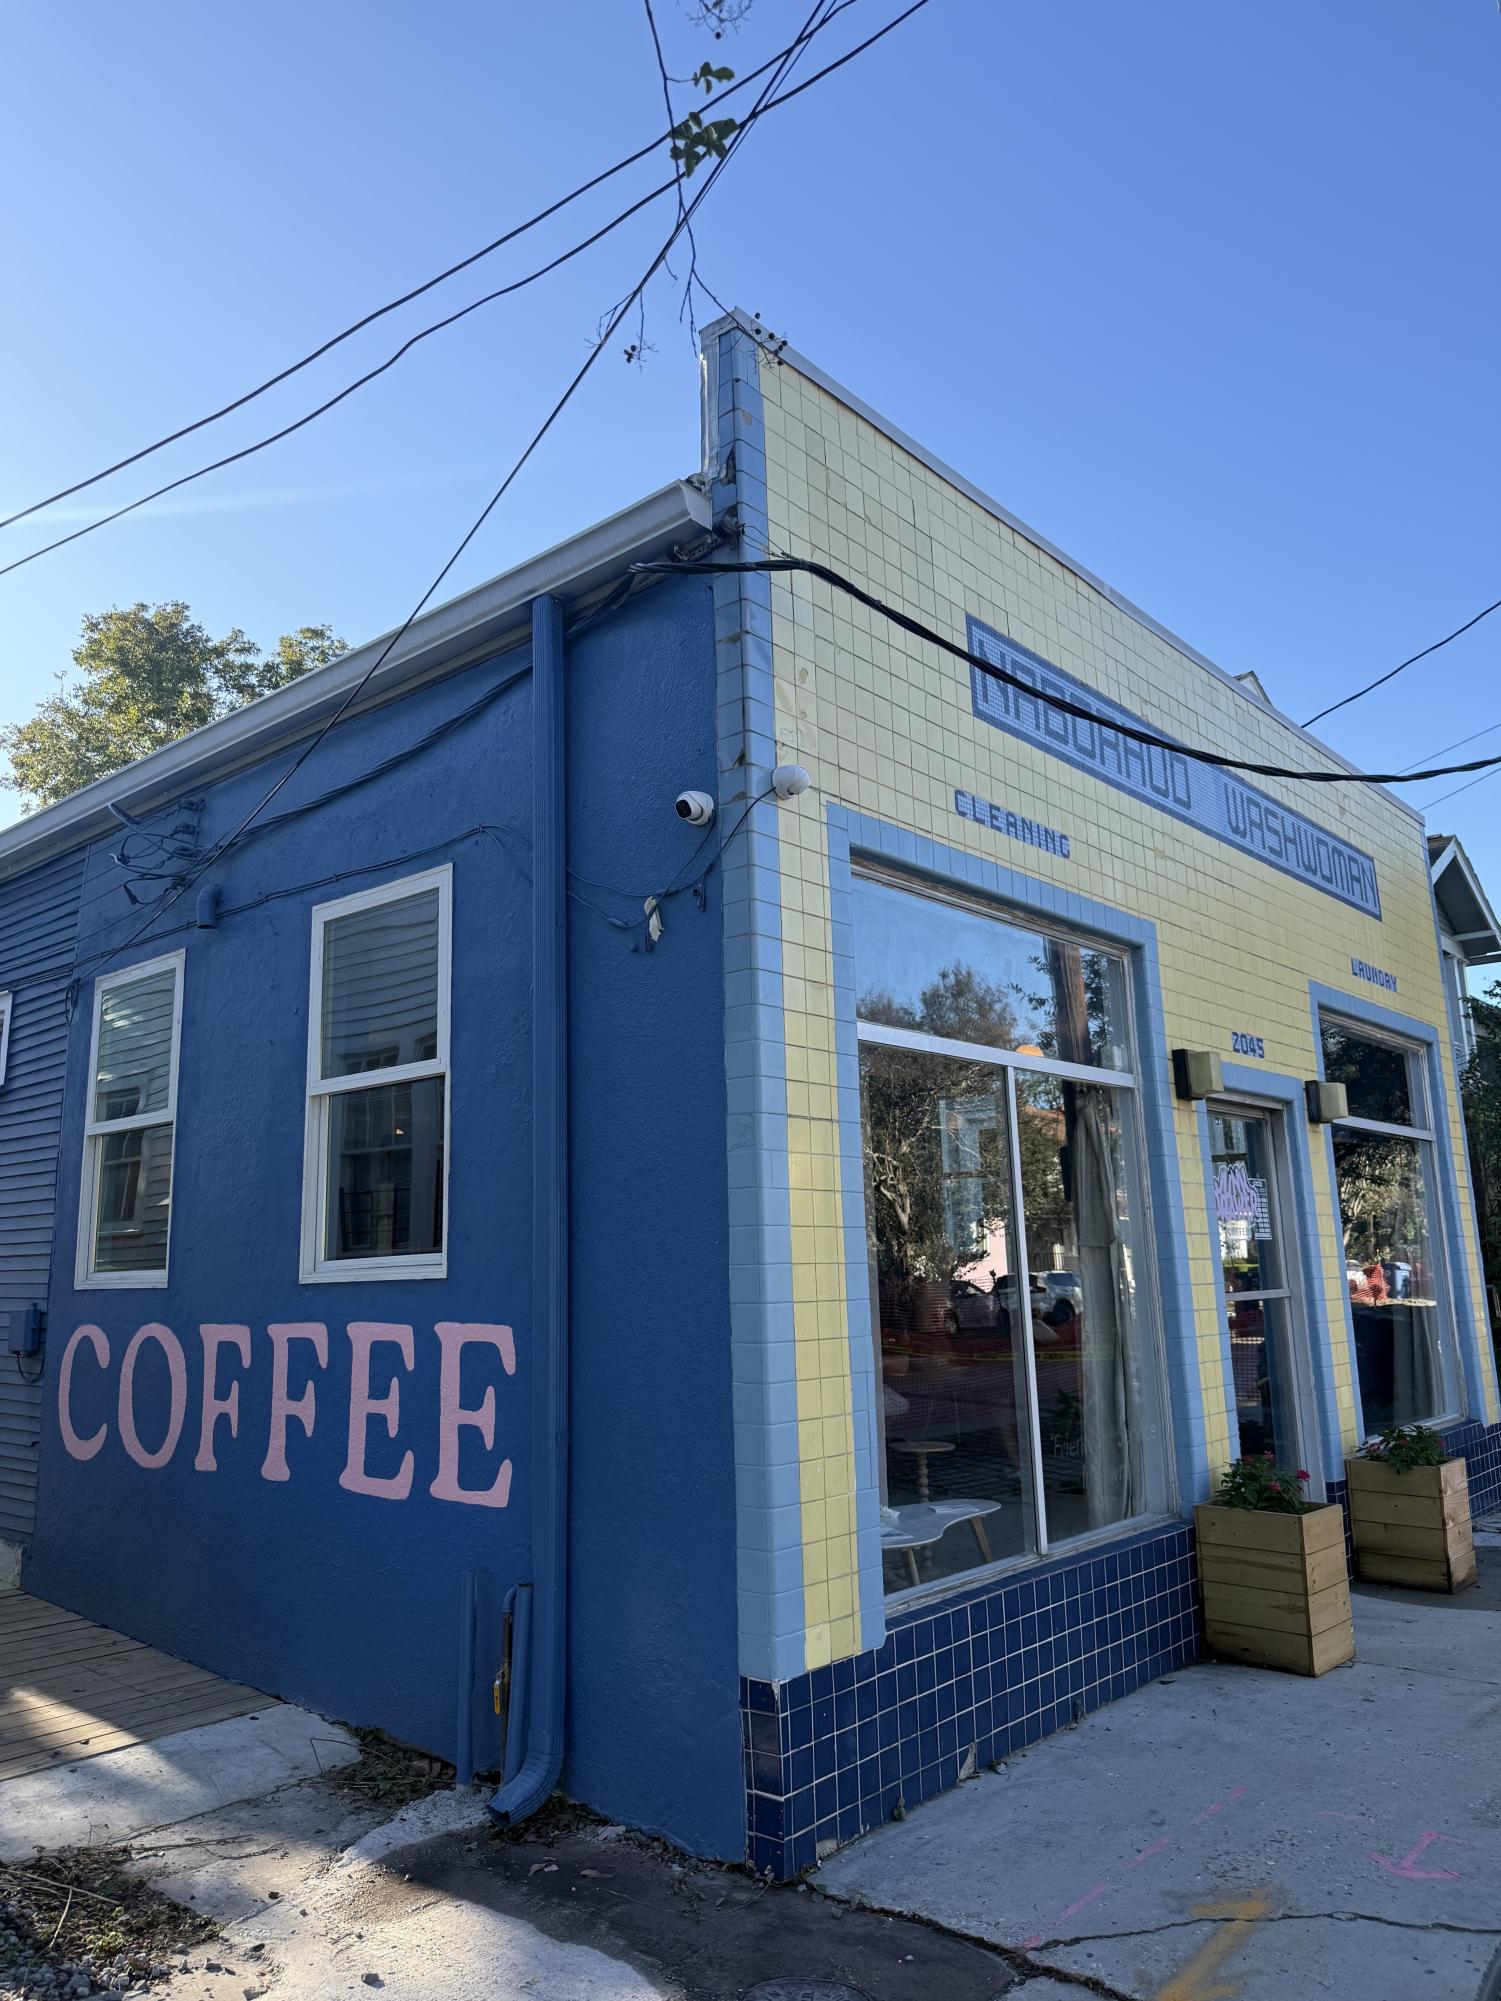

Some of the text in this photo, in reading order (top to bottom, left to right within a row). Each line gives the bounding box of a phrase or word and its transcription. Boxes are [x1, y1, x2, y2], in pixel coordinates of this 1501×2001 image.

[954, 789, 1070, 859] CLEANING
[1224, 782, 1377, 908] WASHWOMAN
[1351, 957, 1397, 992] LAUNDRY
[1232, 1031, 1264, 1059] 2045
[58, 1322, 516, 1508] COFFEE
